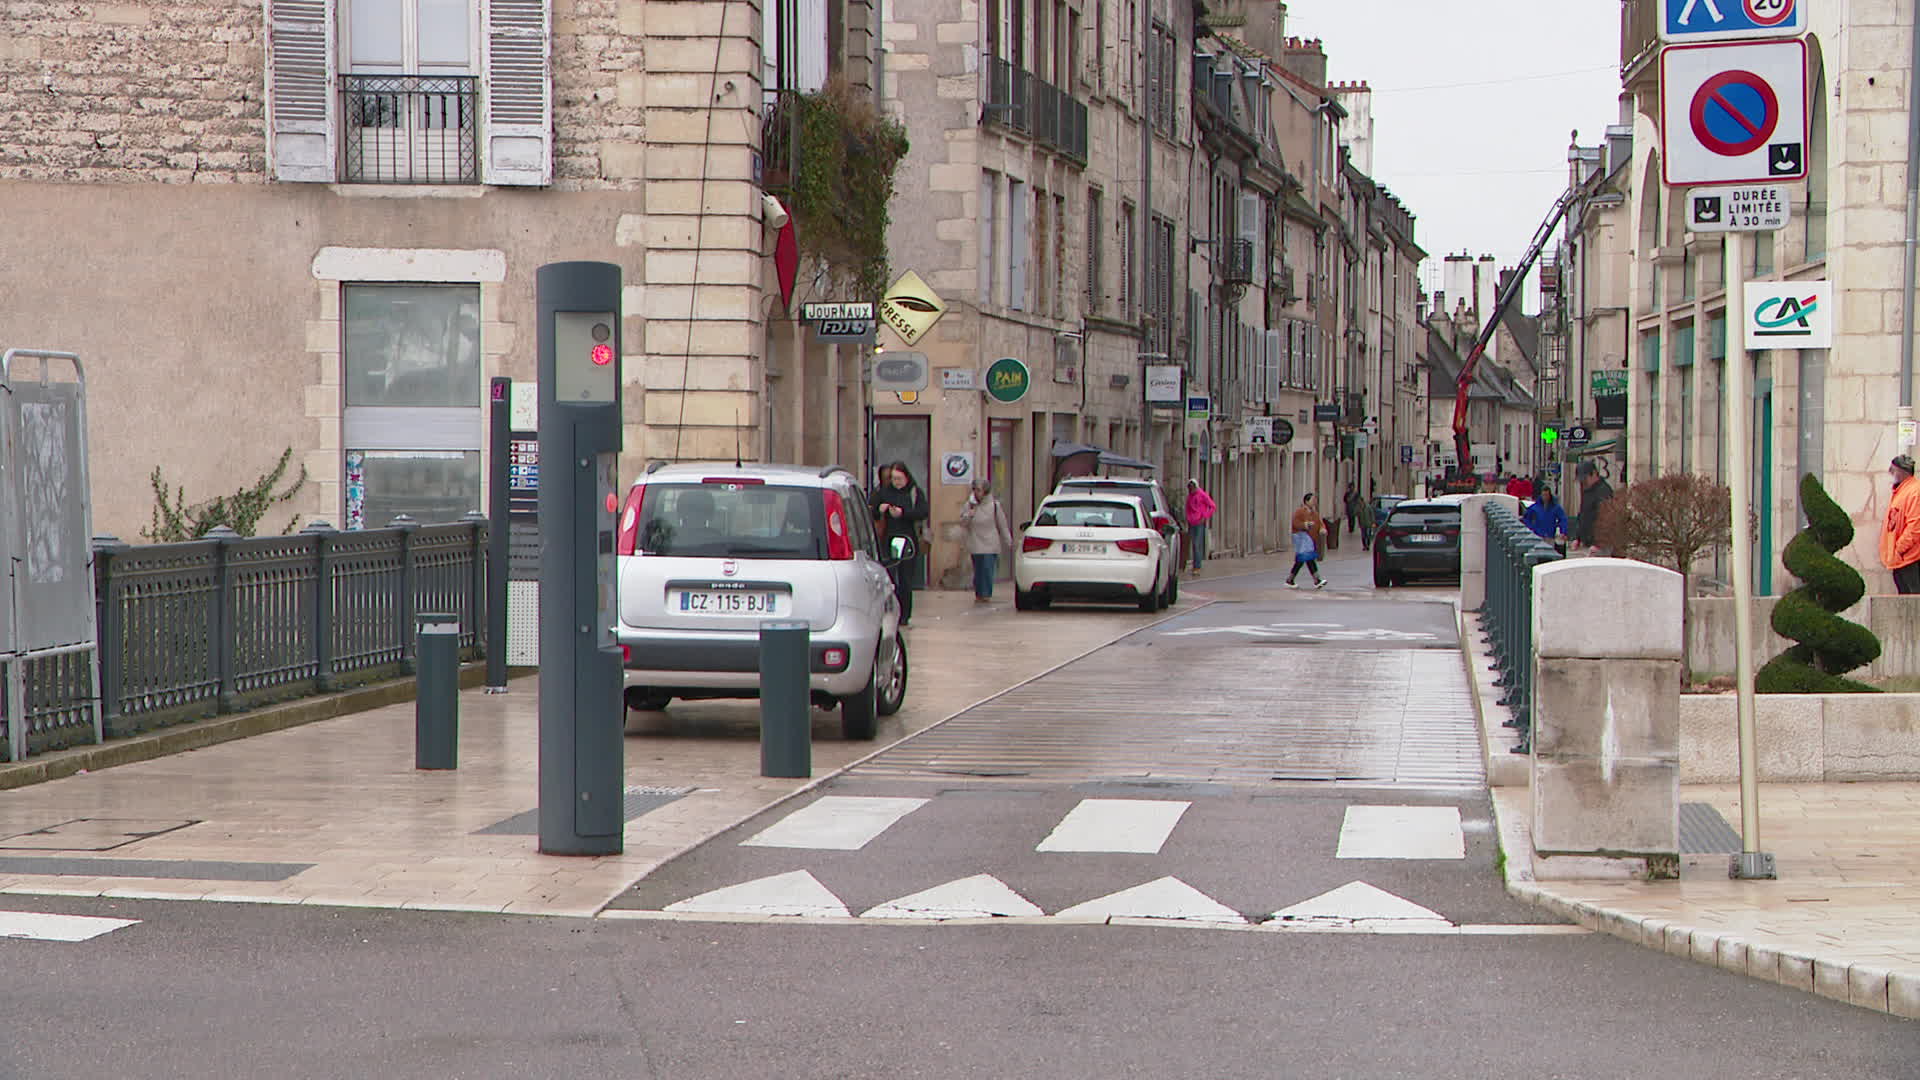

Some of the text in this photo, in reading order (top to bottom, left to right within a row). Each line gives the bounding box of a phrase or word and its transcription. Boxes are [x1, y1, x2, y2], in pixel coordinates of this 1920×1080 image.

[1733, 189, 1777, 201] DURÉE
[1728, 201, 1781, 214] LIMITÉE
[1729, 215, 1781, 227] À 30 min
[1754, 295, 1817, 328] CA
[880, 302, 917, 340] PRESSE
[823, 322, 850, 334] FDJ
[995, 370, 1024, 385] PAIN
[711, 582, 746, 590] panda
